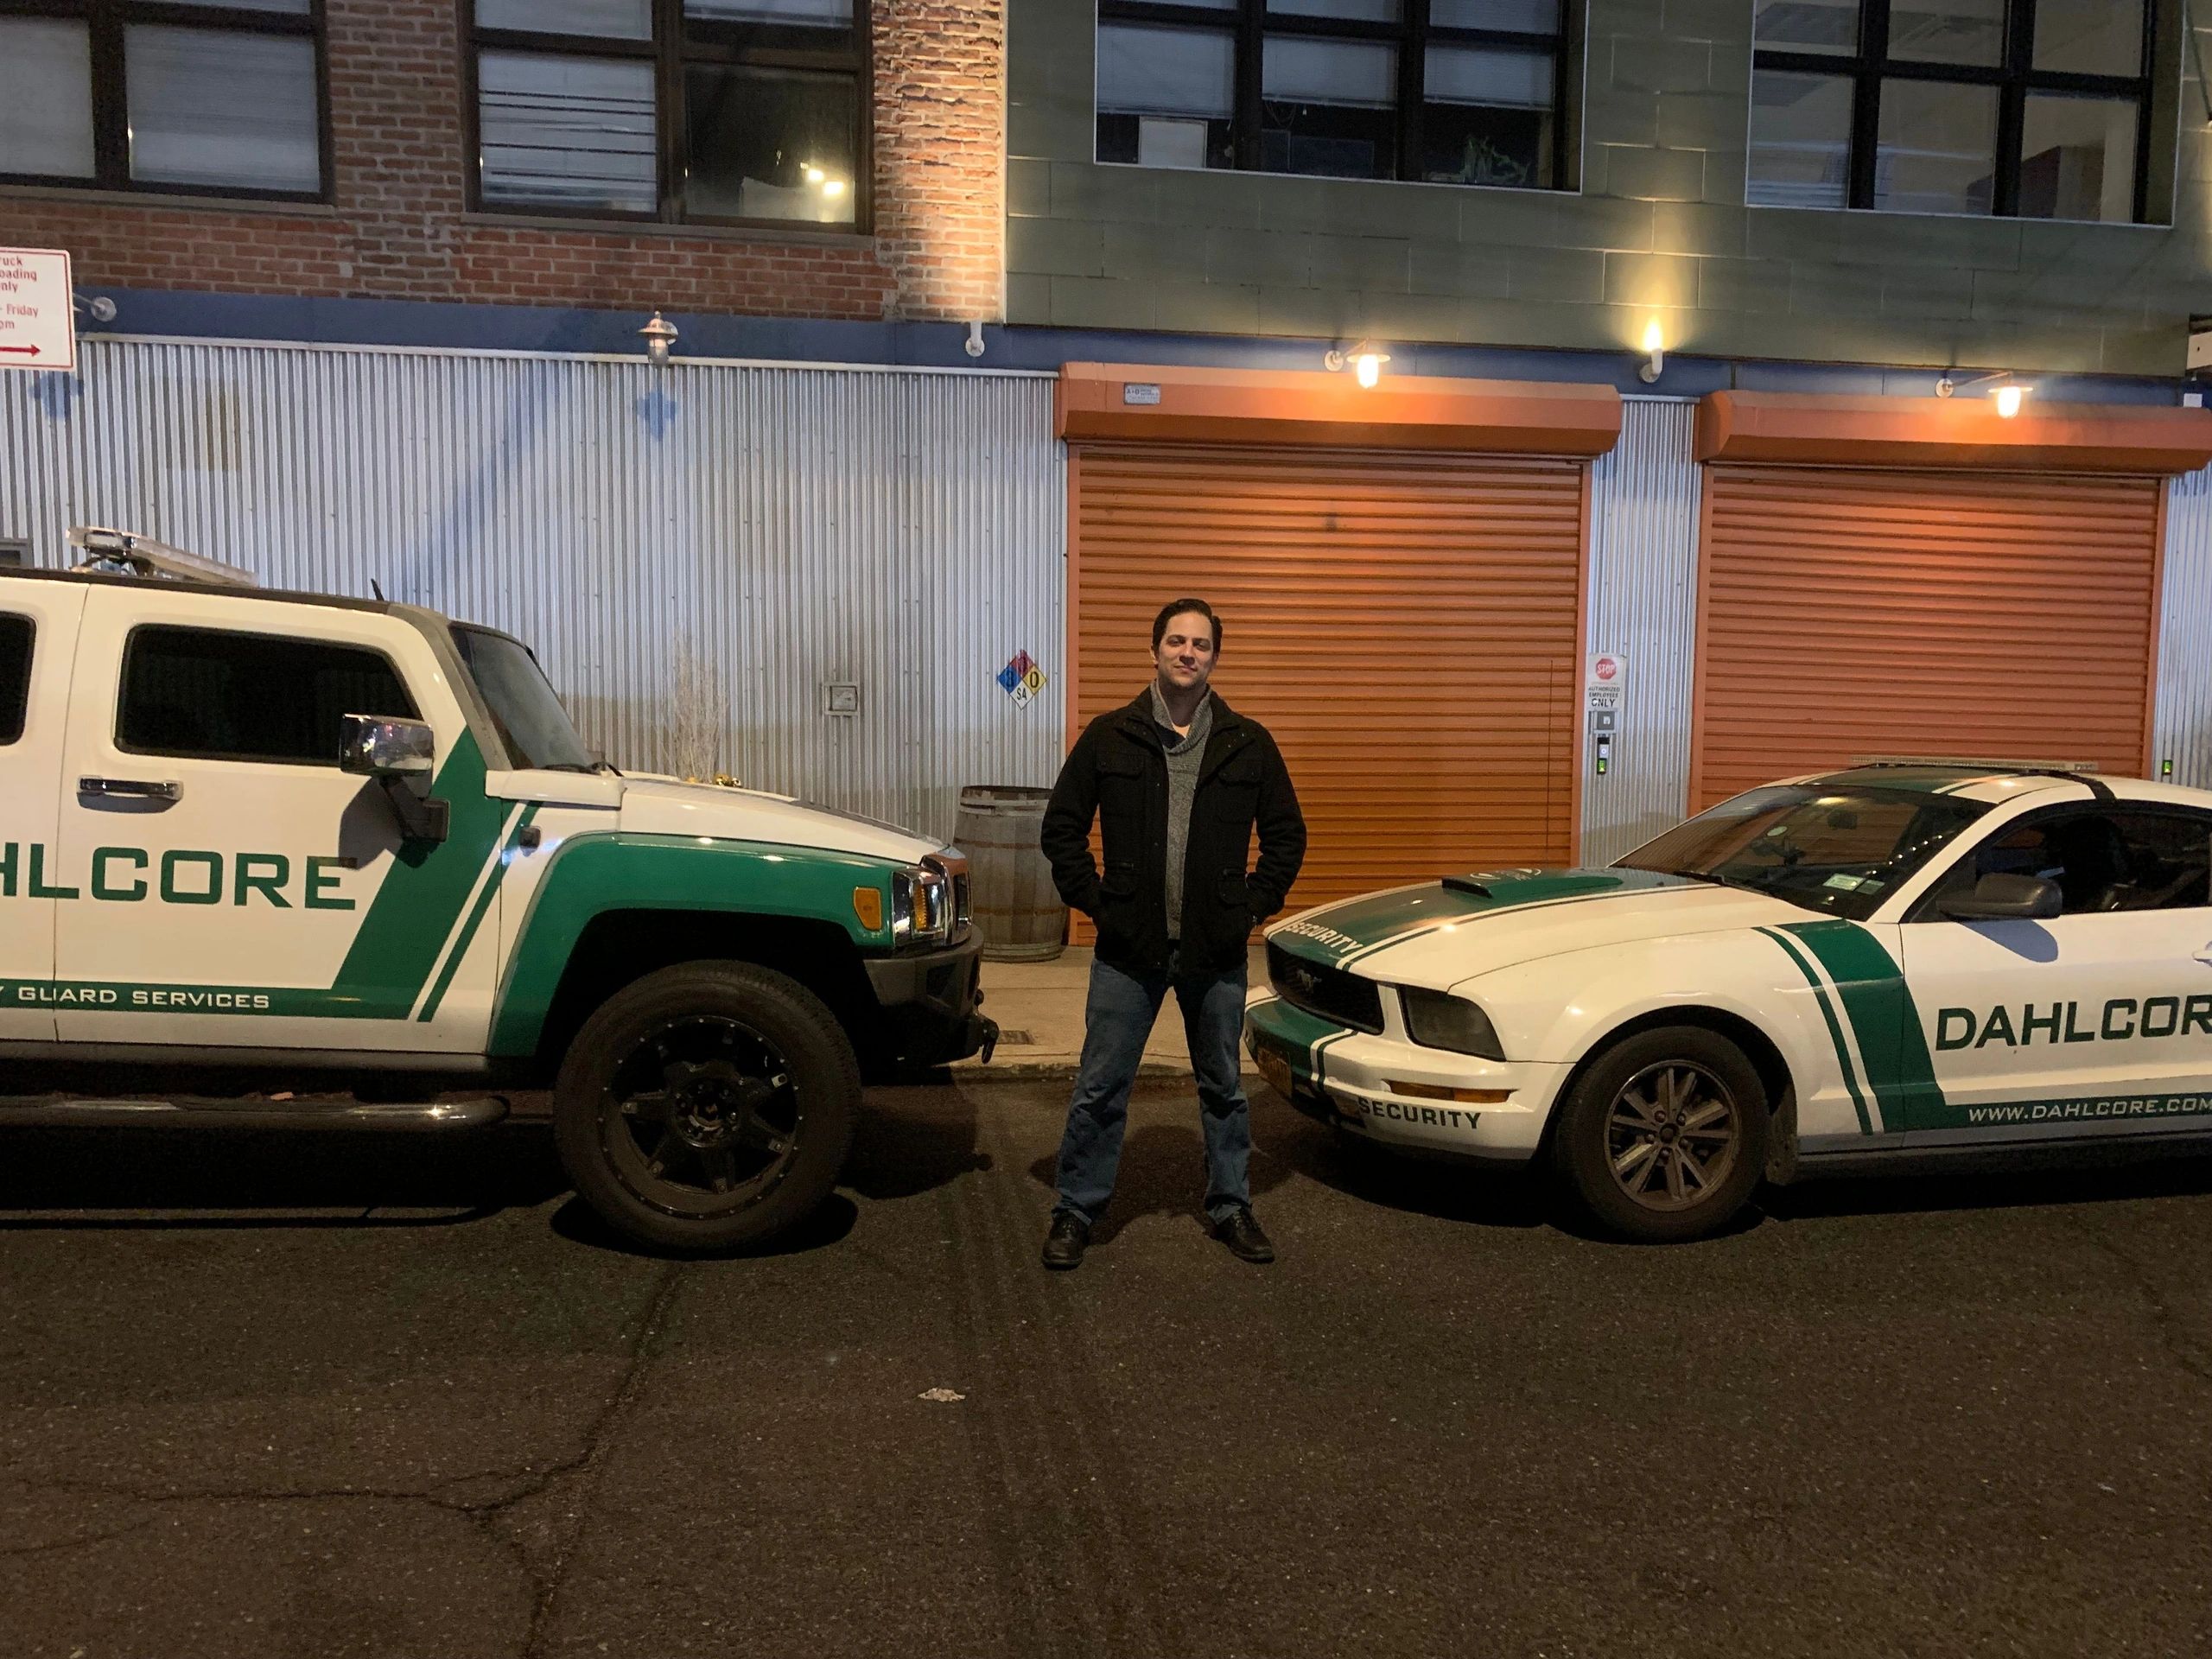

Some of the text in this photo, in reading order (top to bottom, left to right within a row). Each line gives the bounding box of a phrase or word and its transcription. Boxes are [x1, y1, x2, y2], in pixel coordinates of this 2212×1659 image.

[0, 256, 22, 266] uck
[6, 303, 39, 319] Friday
[1597, 664, 1616, 674] STOP
[1029, 671, 1039, 688] 0
[1016, 687, 1027, 701] SA
[1591, 698, 1616, 708] ONLY
[1284, 921, 1363, 954] SECURITY
[18, 986, 270, 1008] GUARD SERVICES
[1936, 995, 2212, 1051] DAHLCOR
[1358, 1096, 1481, 1129] SECURITY
